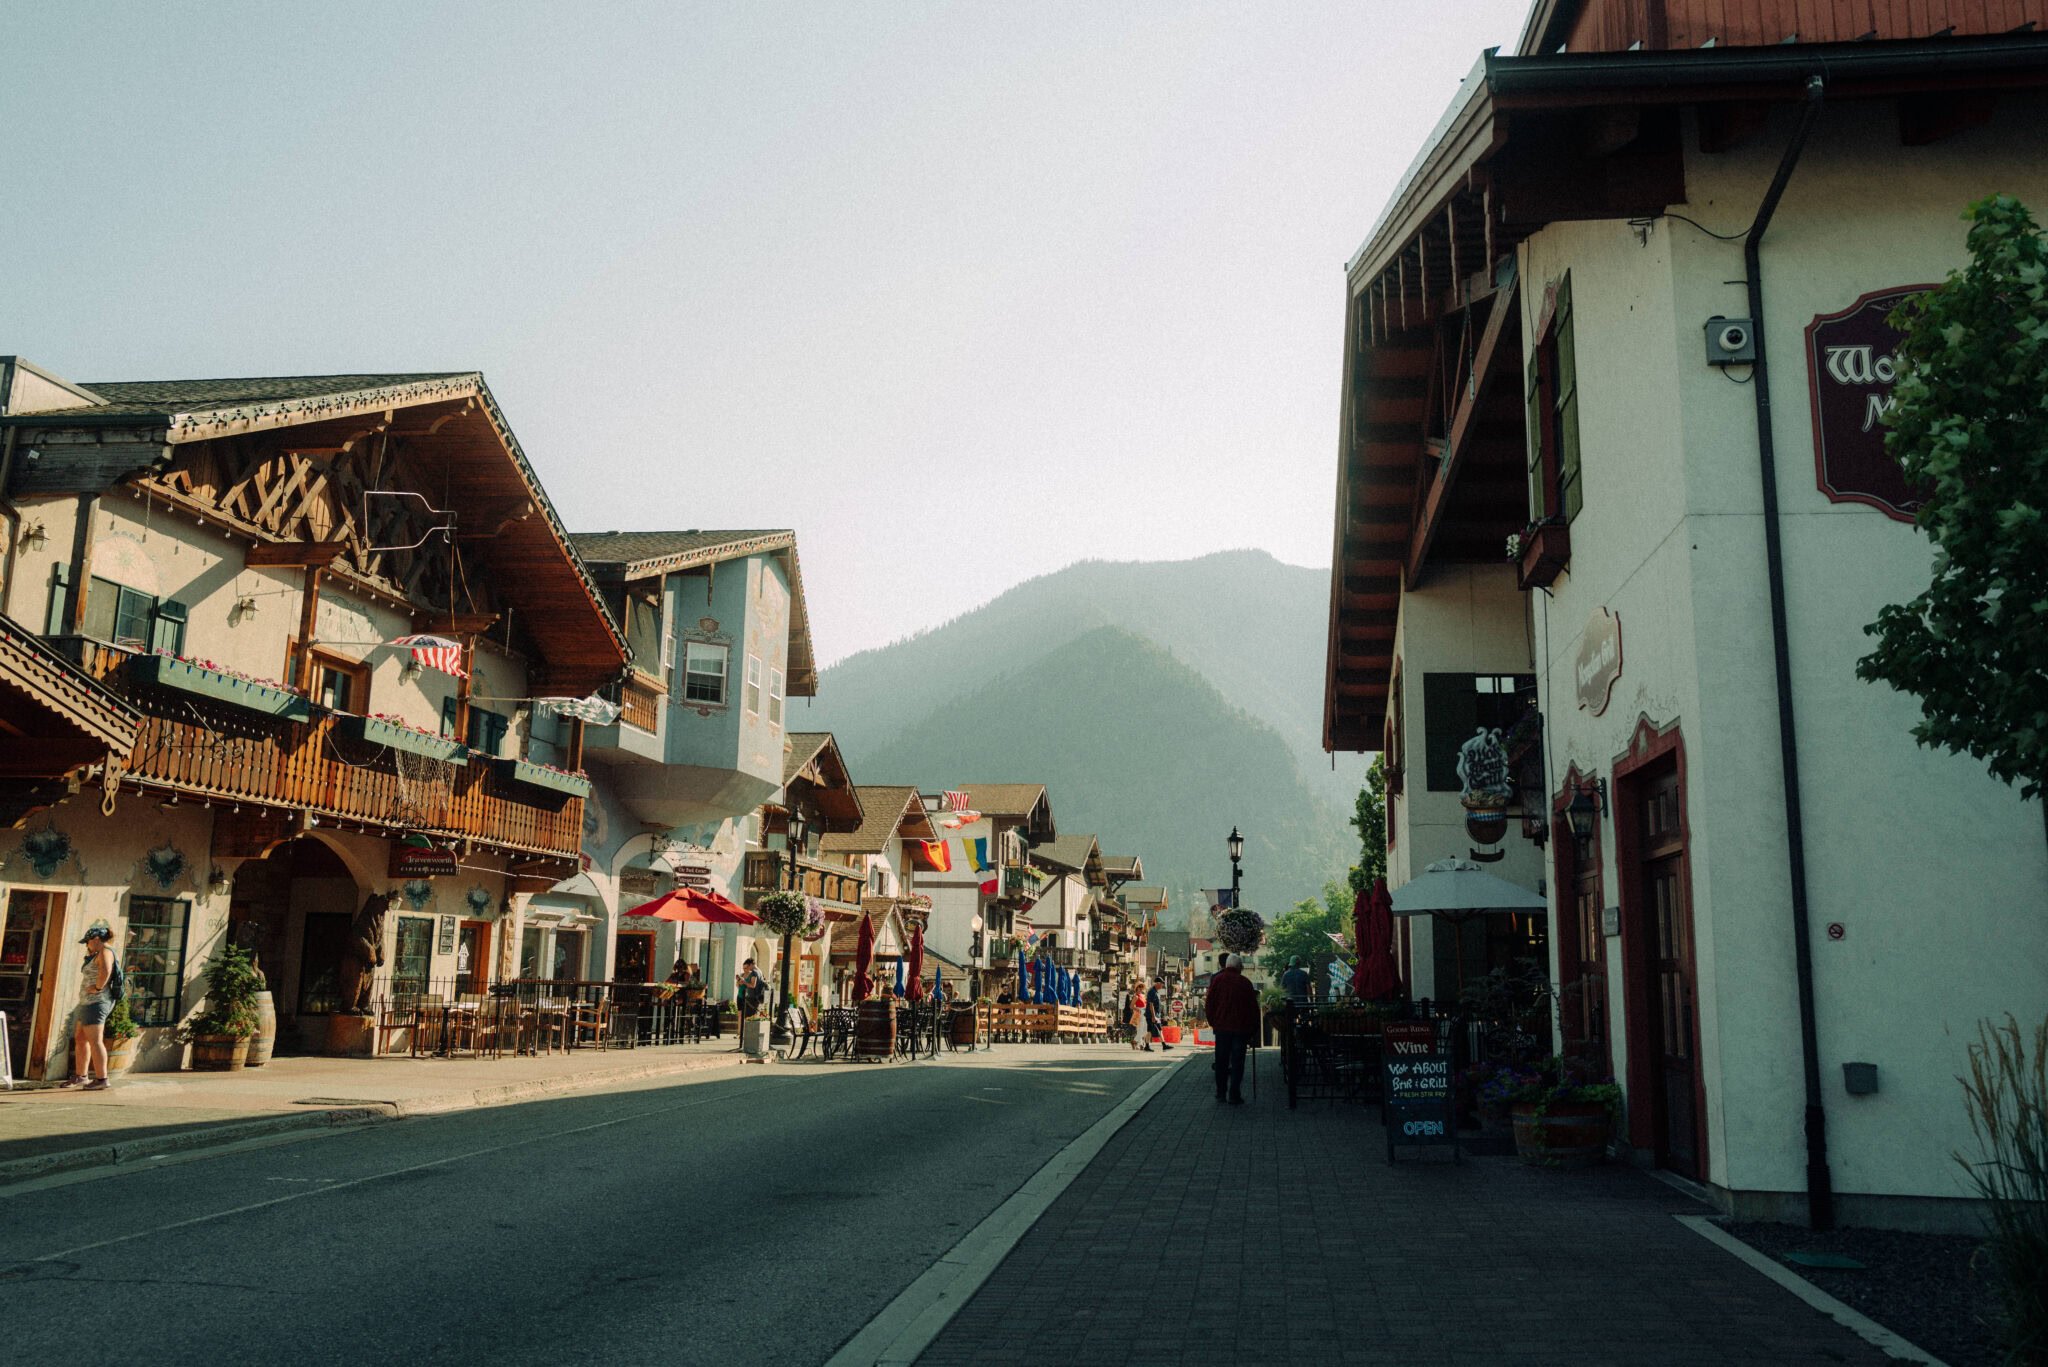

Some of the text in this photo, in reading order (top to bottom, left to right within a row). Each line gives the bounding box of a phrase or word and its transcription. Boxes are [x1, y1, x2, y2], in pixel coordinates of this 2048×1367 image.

[1393, 1041, 1429, 1054] Wine
[1412, 1061, 1448, 1075] ABOUT
[1403, 1120, 1444, 1136] OPEN
